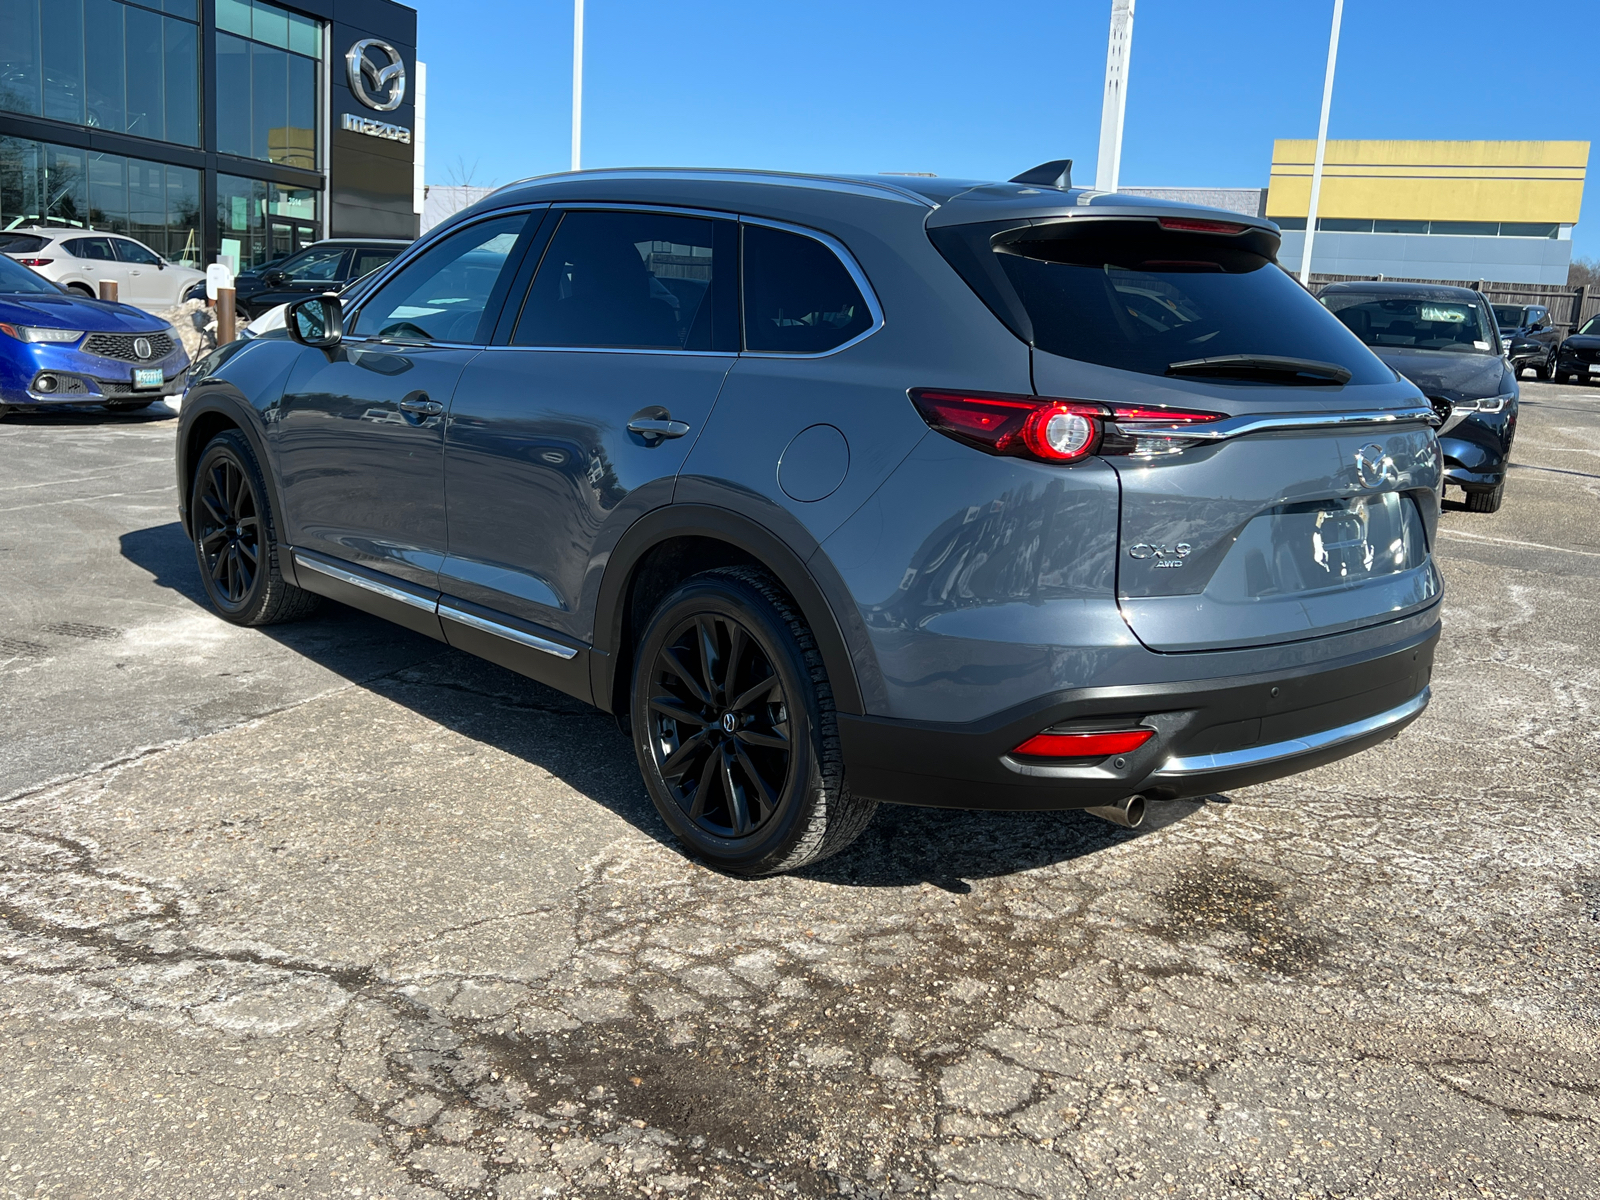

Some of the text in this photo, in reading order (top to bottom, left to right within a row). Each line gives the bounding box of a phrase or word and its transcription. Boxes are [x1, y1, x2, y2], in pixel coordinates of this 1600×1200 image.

[341, 113, 411, 145] mazda
[1129, 542, 1192, 559] CX-9
[1154, 560, 1183, 568] AWD
